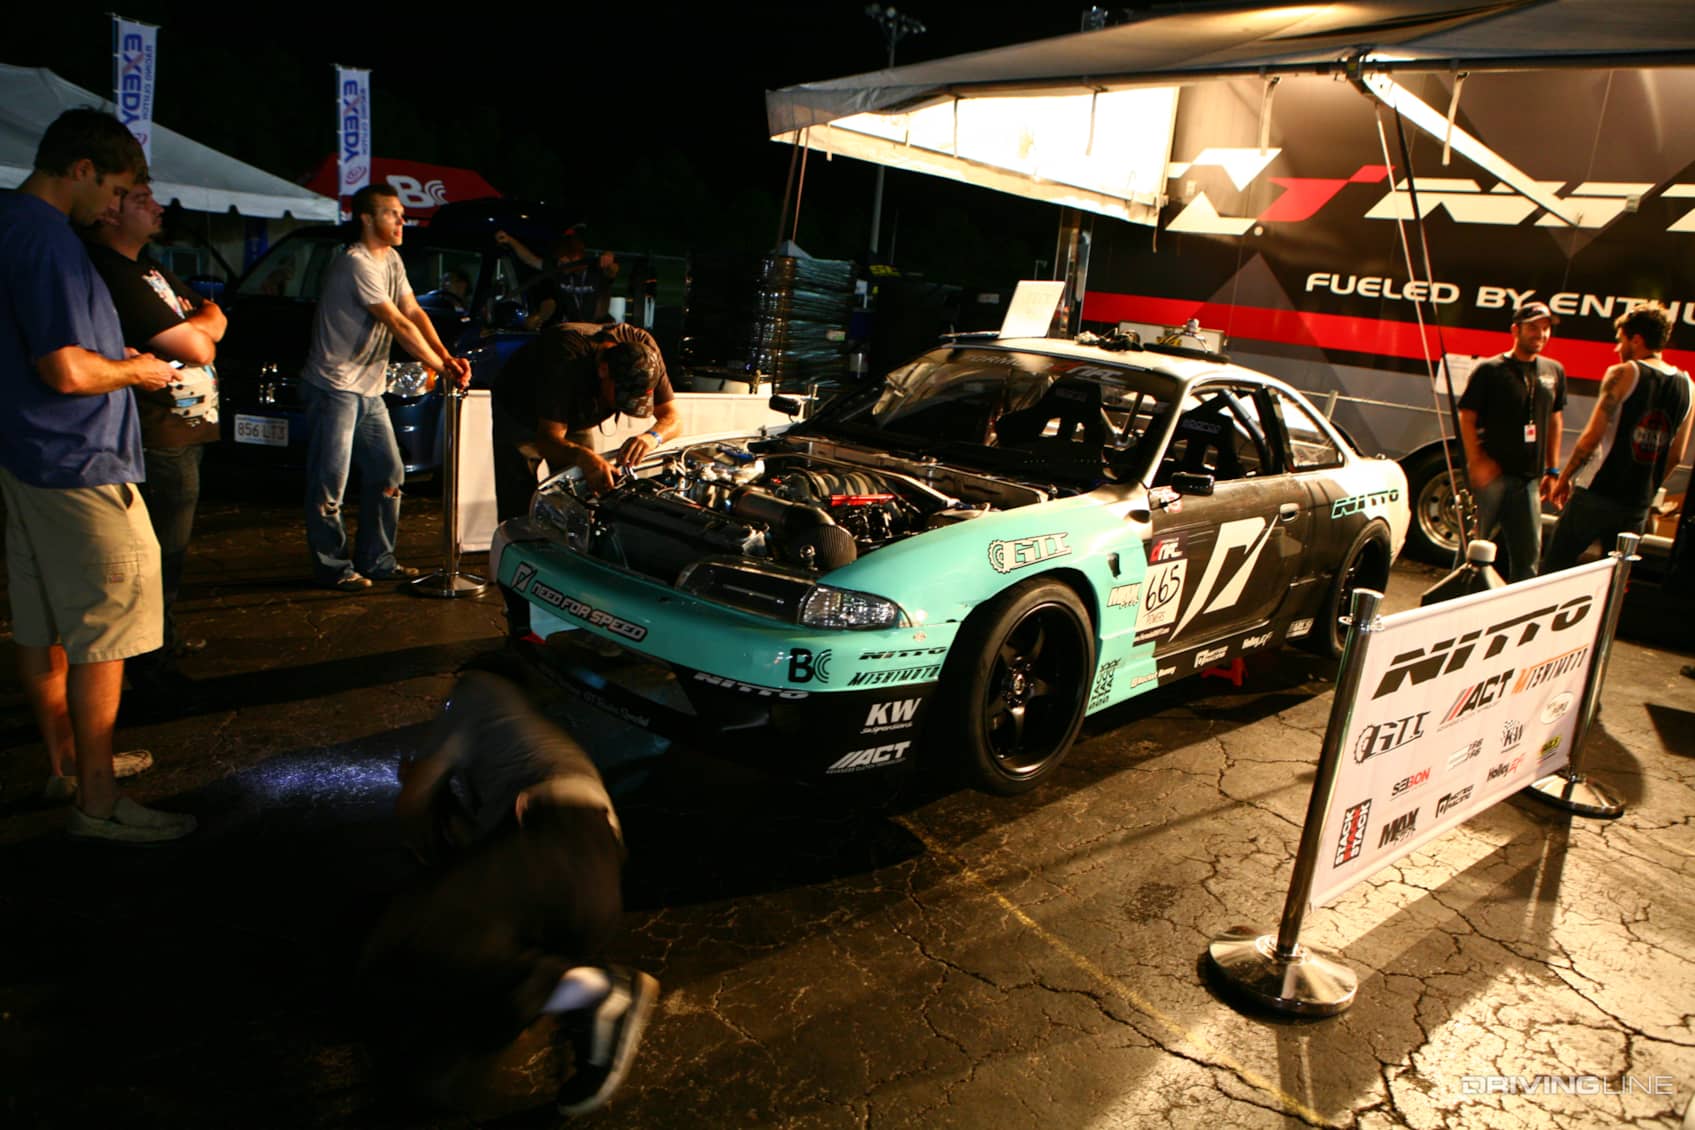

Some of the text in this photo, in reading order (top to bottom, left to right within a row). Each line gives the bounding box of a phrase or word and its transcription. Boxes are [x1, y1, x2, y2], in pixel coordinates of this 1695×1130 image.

[1304, 272, 1461, 304] FUELED
[1475, 285, 1537, 311] BY
[1331, 489, 1399, 520] NITTO
[1144, 564, 1181, 613] 665
[532, 581, 647, 641] NEED FOR SPEED
[859, 646, 947, 661] NITTO
[1371, 595, 1593, 700] NITTO
[692, 672, 809, 700] NITTO
[847, 664, 941, 687] MISHIMOTO
[864, 697, 923, 727] KW
